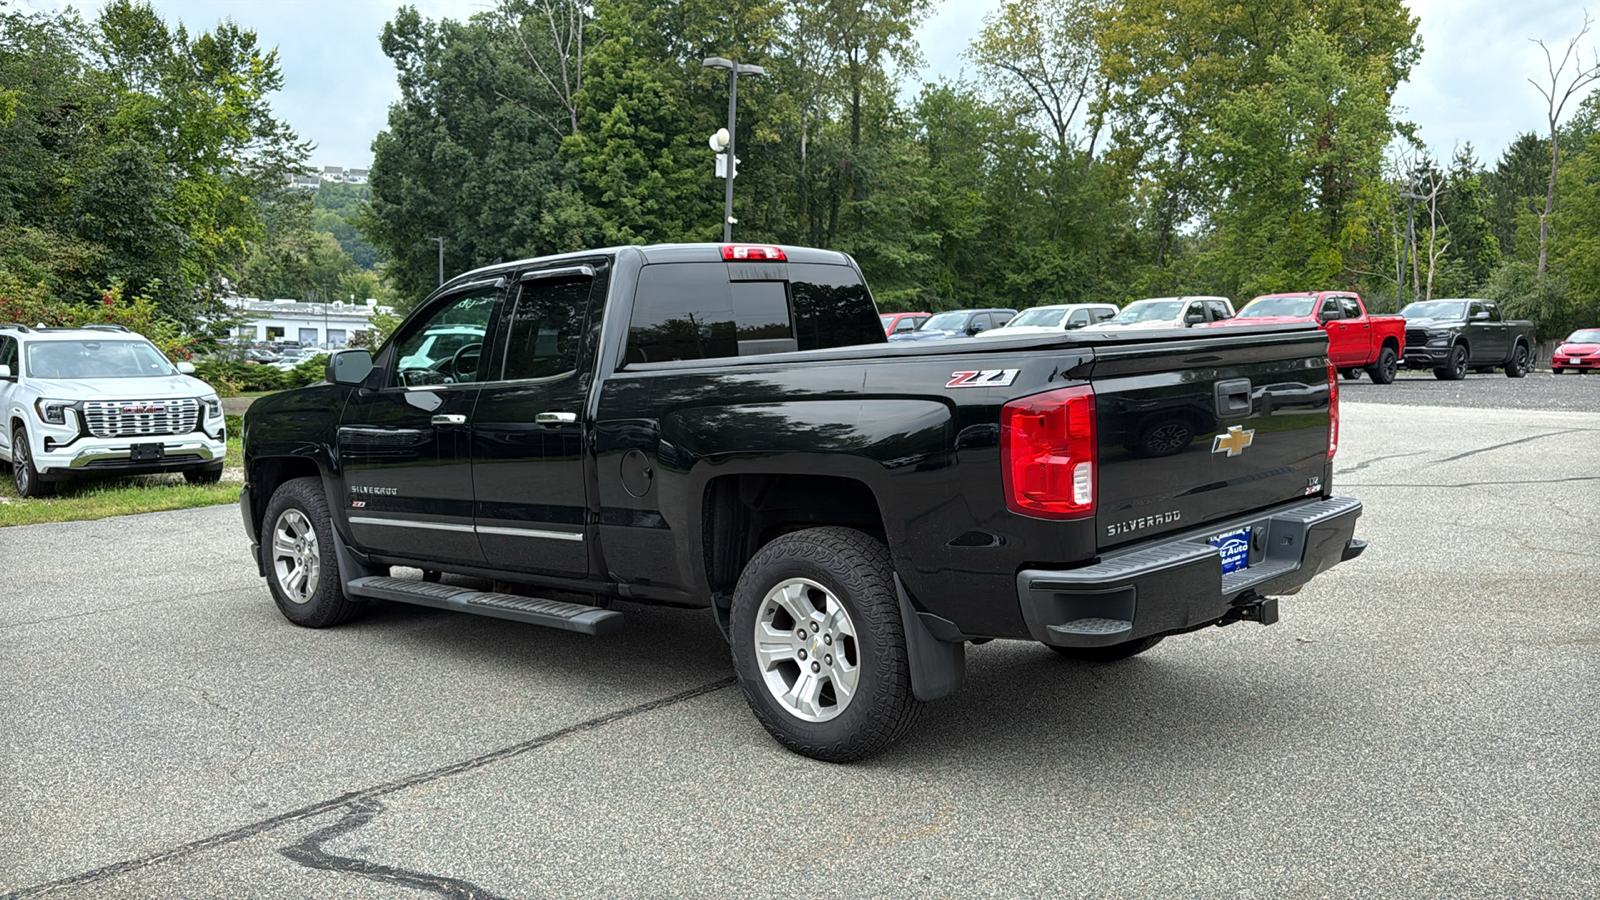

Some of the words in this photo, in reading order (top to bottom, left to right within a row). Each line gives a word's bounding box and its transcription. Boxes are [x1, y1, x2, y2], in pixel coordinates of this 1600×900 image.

[945, 369, 1021, 388] Z71
[123, 405, 165, 414] GMC
[351, 485, 398, 495] SILVERADO
[1107, 510, 1181, 537] SILVERADO
[1227, 545, 1248, 556] Auto
